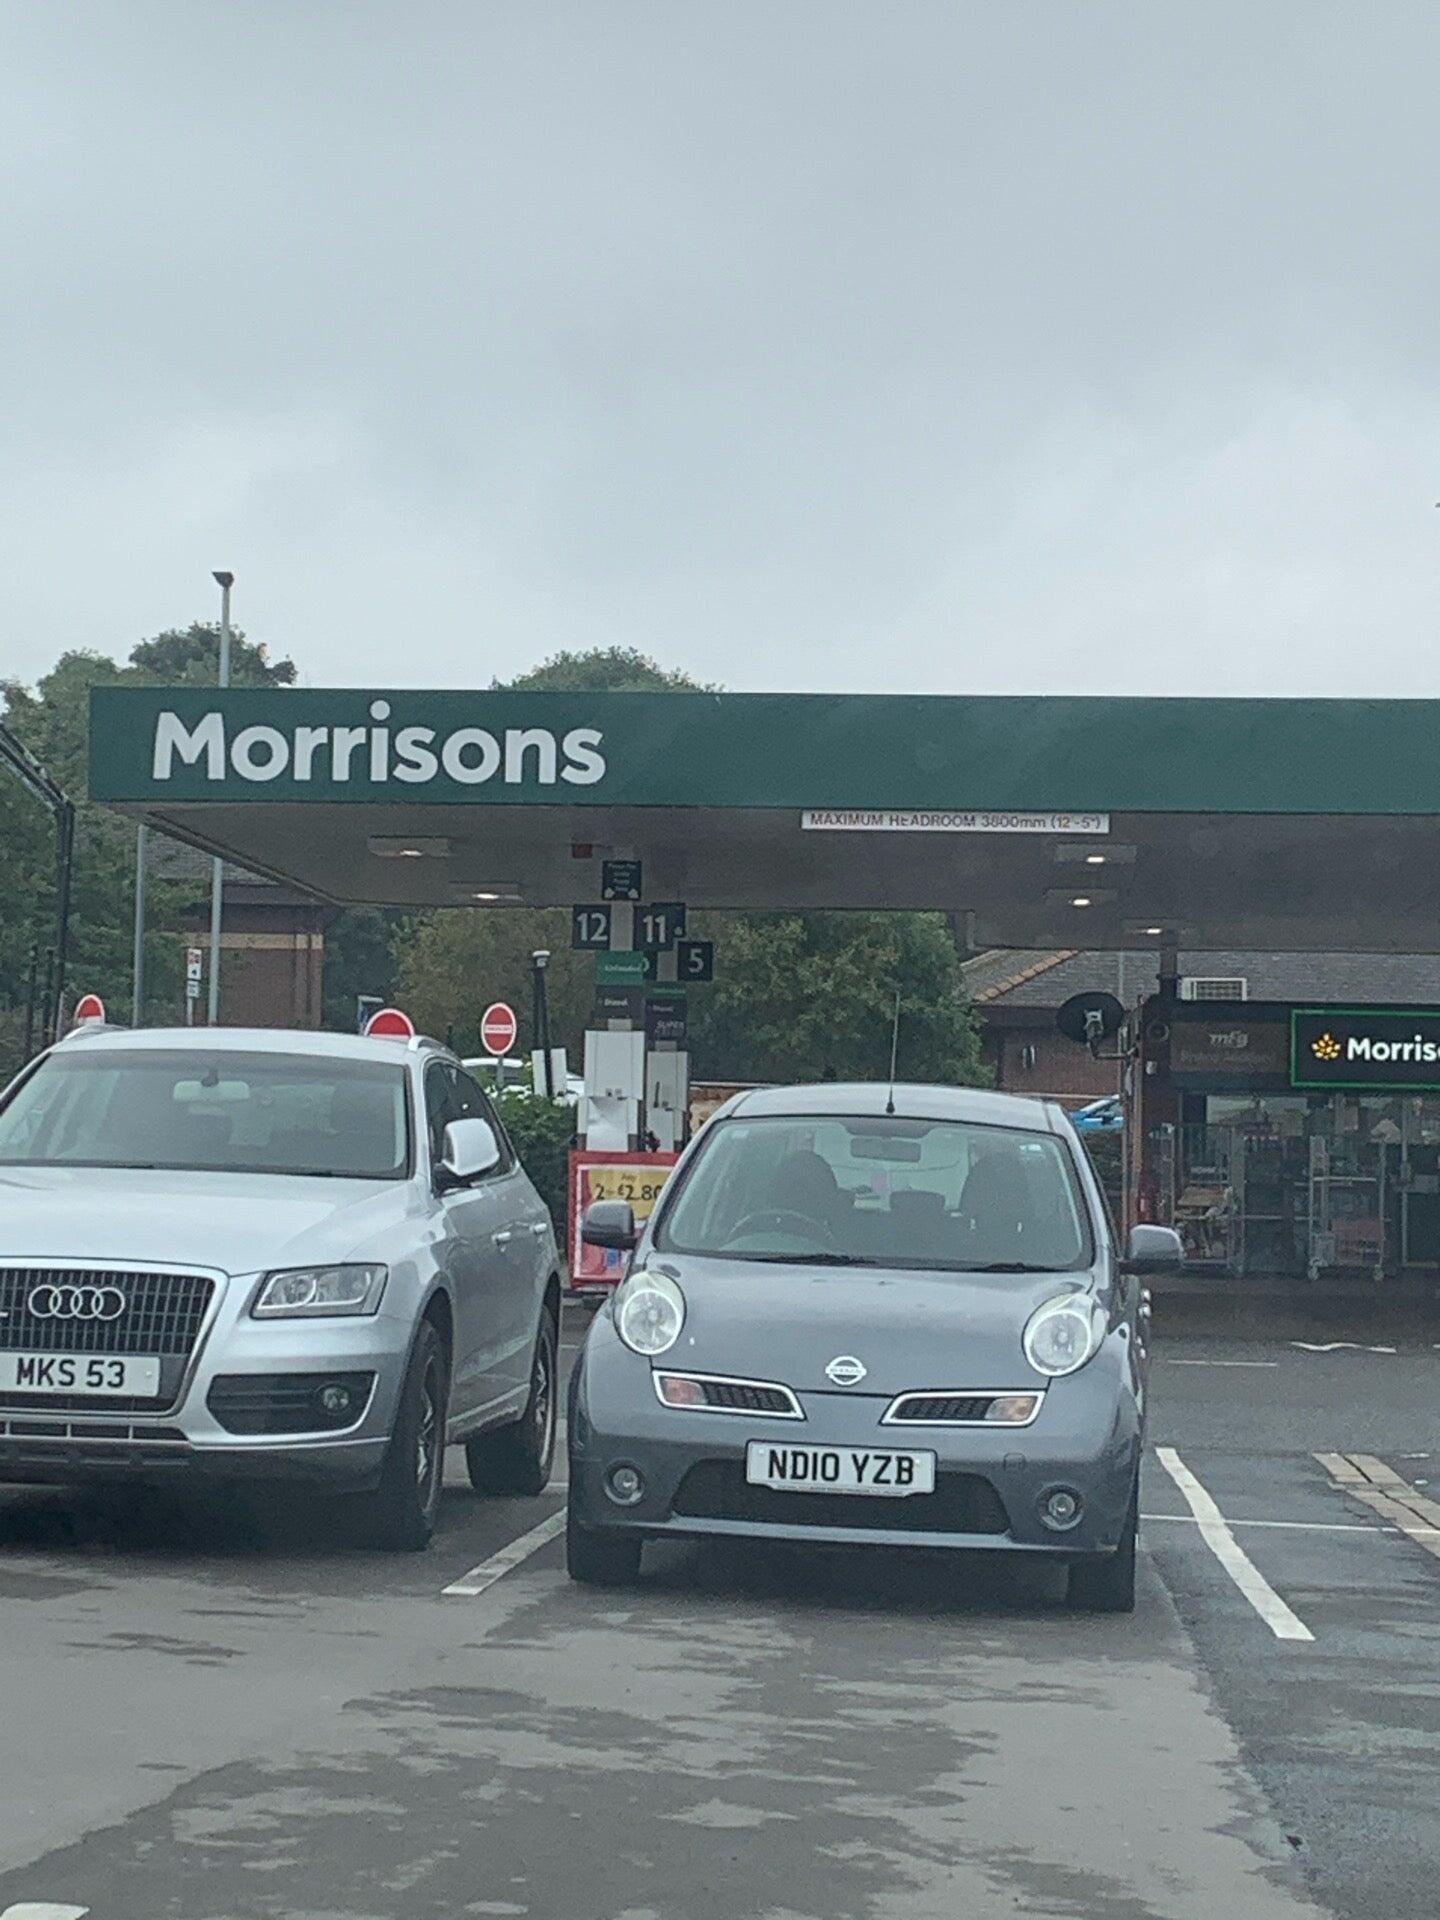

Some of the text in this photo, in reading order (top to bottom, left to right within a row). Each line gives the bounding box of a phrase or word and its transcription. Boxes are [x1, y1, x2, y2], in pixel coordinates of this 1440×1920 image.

[152, 699, 606, 785] Morrisons
[810, 812, 884, 826] MAXIMUM
[888, 814, 976, 828] HEADROOM
[576, 912, 608, 941] 12
[643, 914, 666, 943] 11
[688, 948, 704, 973] 5
[1347, 1034, 1440, 1062] Morris
[595, 1183, 605, 1200] 2
[16, 1357, 125, 1388] MKS 53
[768, 1449, 914, 1485] ND10 YZB
